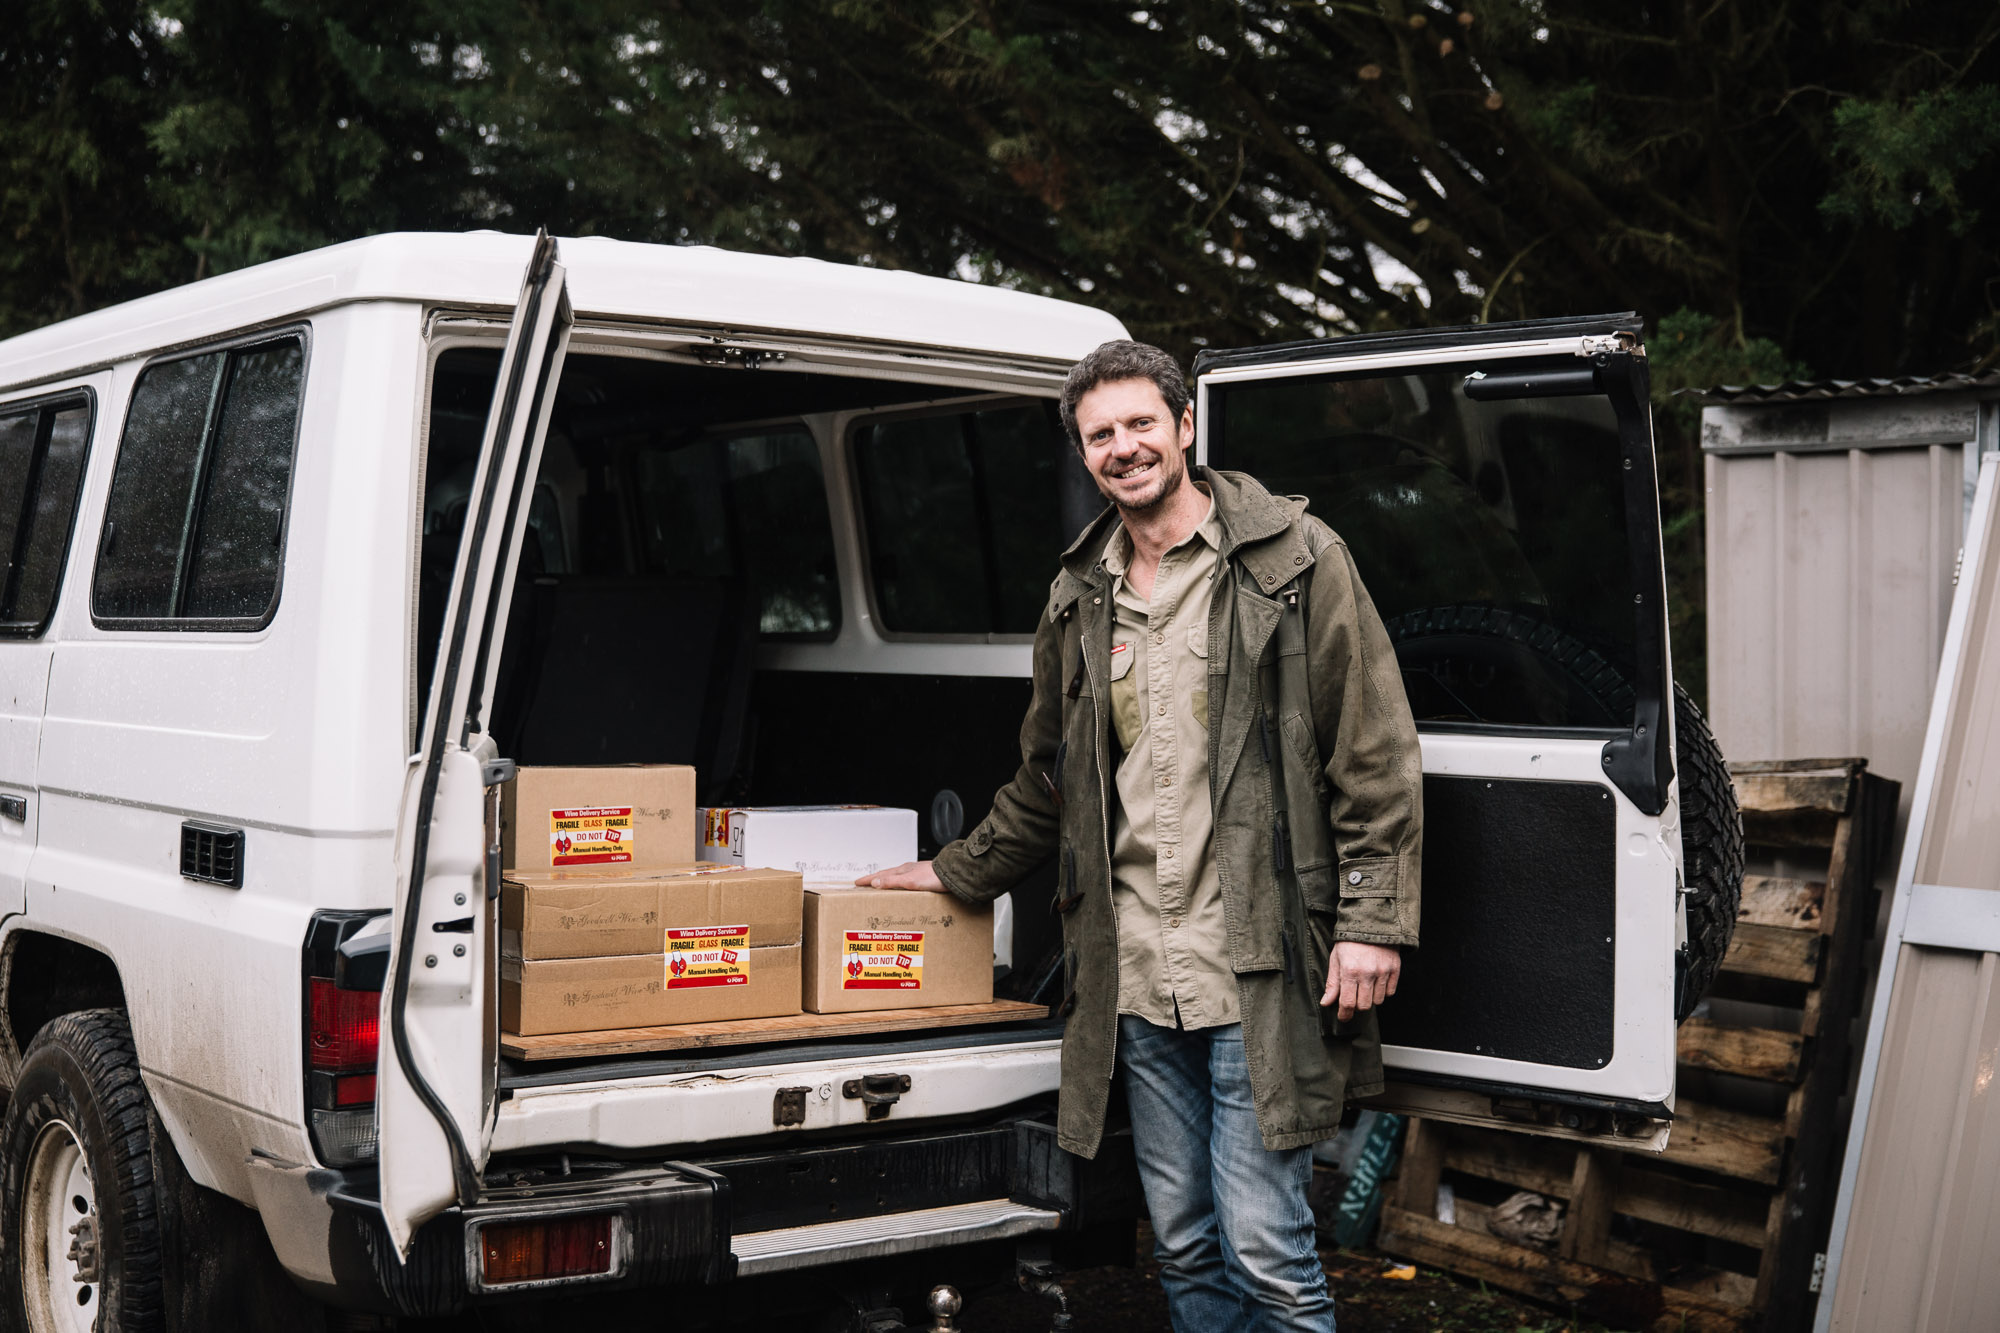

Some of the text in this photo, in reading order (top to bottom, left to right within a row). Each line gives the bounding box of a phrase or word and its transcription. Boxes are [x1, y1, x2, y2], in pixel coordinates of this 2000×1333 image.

[579, 809, 600, 817] Delivery
[556, 819, 628, 829] FRAGILE GLASS FRAGILE
[576, 830, 619, 841] DO NOT TIP
[695, 929, 717, 937] Delivery
[671, 938, 744, 950] FRAGILE GLASS FRAGILE
[897, 944, 919, 952] FRAGILE
[692, 951, 735, 962] DO NOT TIP
[868, 956, 910, 966] DO NOT TIP
